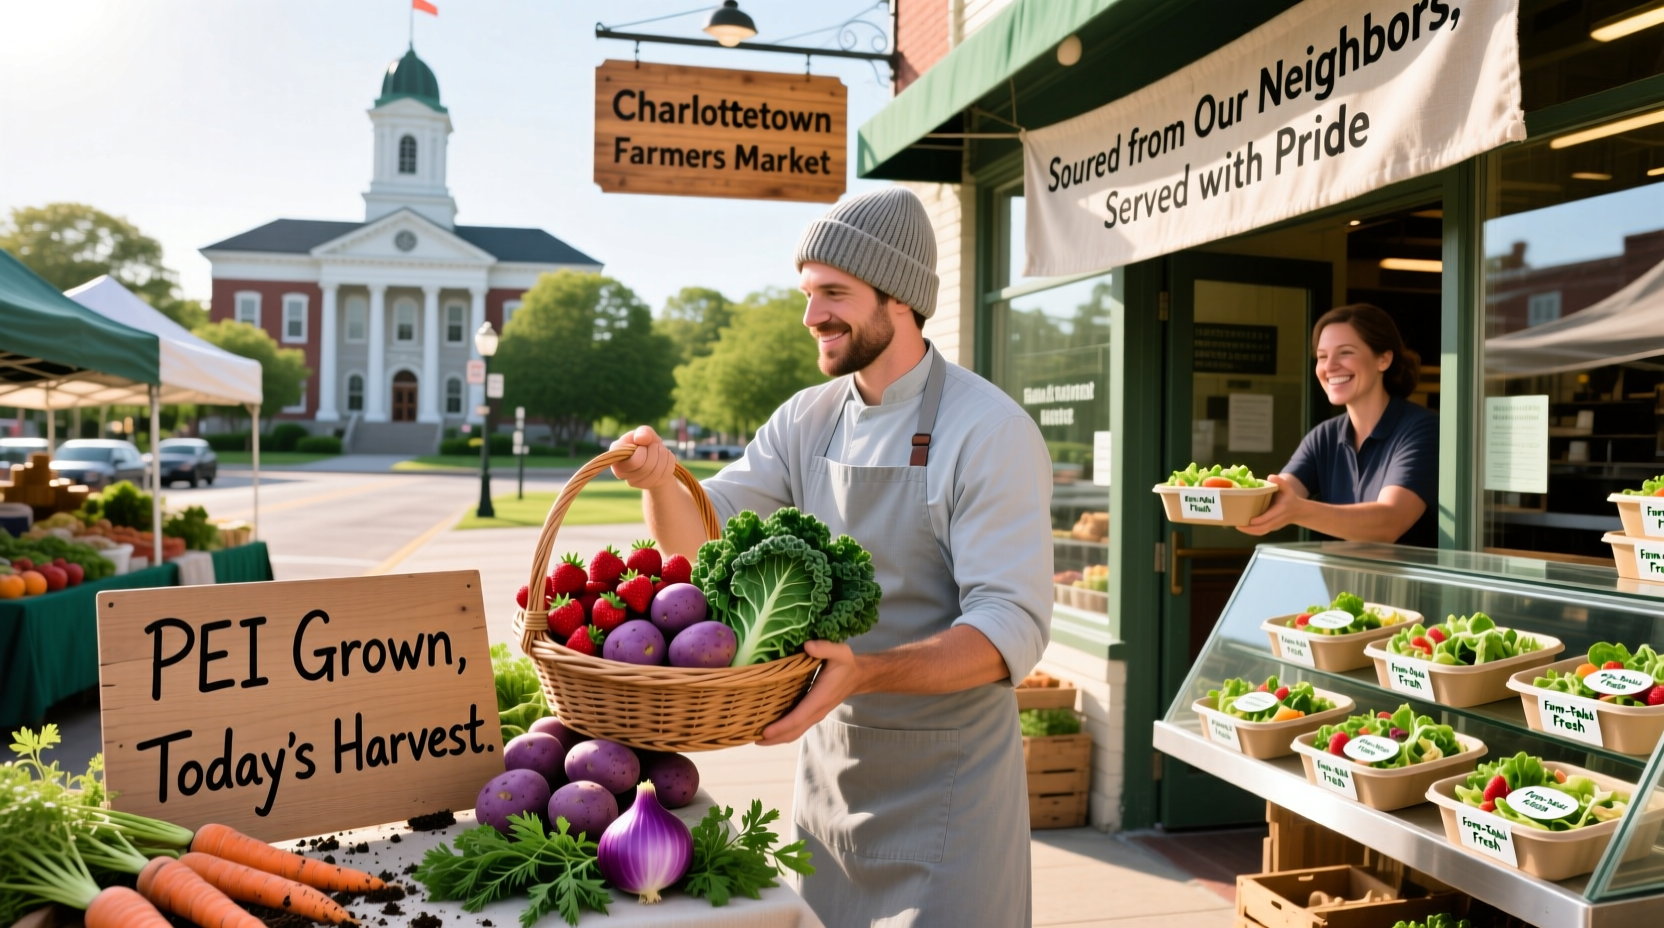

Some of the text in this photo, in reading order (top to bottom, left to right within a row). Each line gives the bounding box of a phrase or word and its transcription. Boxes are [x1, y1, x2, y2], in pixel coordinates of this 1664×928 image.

[612, 89, 832, 133] Charlottetown
[1048, 0, 1462, 192] Soured from Our Neighbors,
[614, 136, 832, 175] Farmers Market
[1103, 104, 1371, 229] Served with Pride
[144, 609, 467, 701] PEI Grown,
[136, 703, 495, 817] Today's Harvest.
[1553, 714, 1585, 733] Fresh
